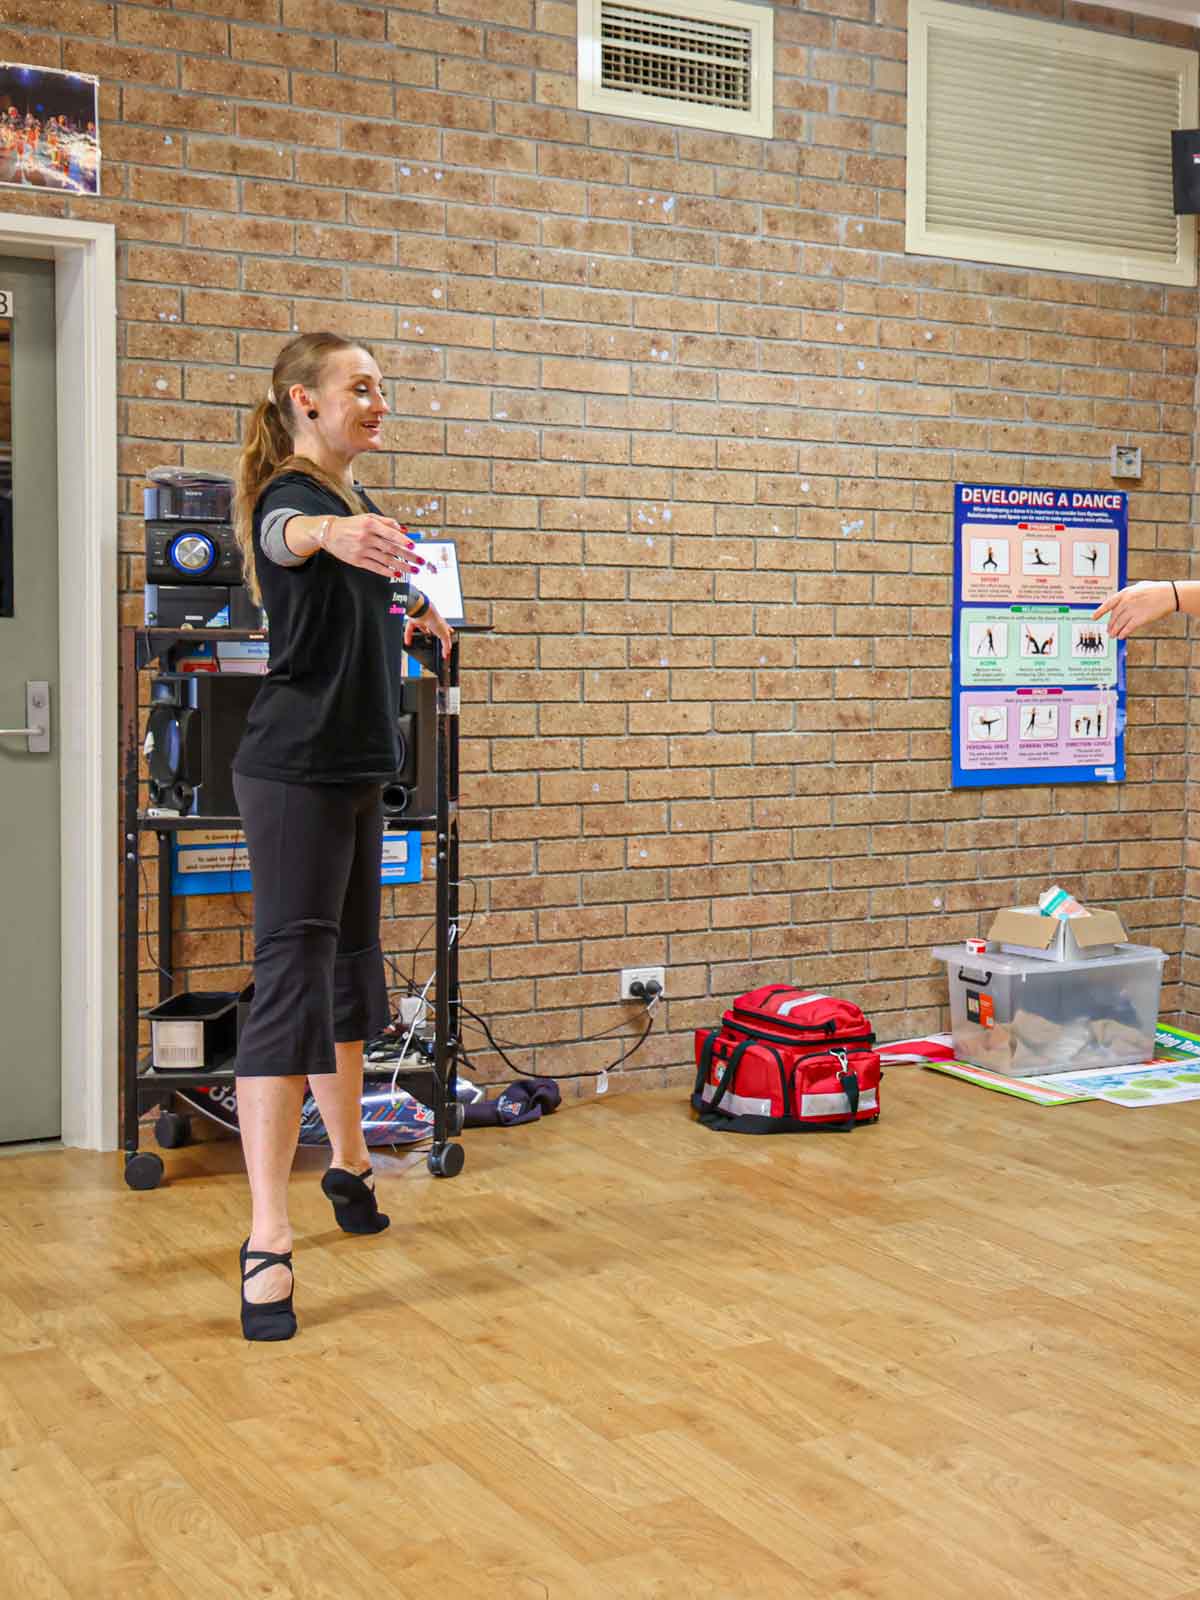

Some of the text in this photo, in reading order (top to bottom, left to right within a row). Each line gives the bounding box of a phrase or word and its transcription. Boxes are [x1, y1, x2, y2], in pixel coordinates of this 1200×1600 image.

[962, 488, 1122, 509] DEVELOPING A DANCE
